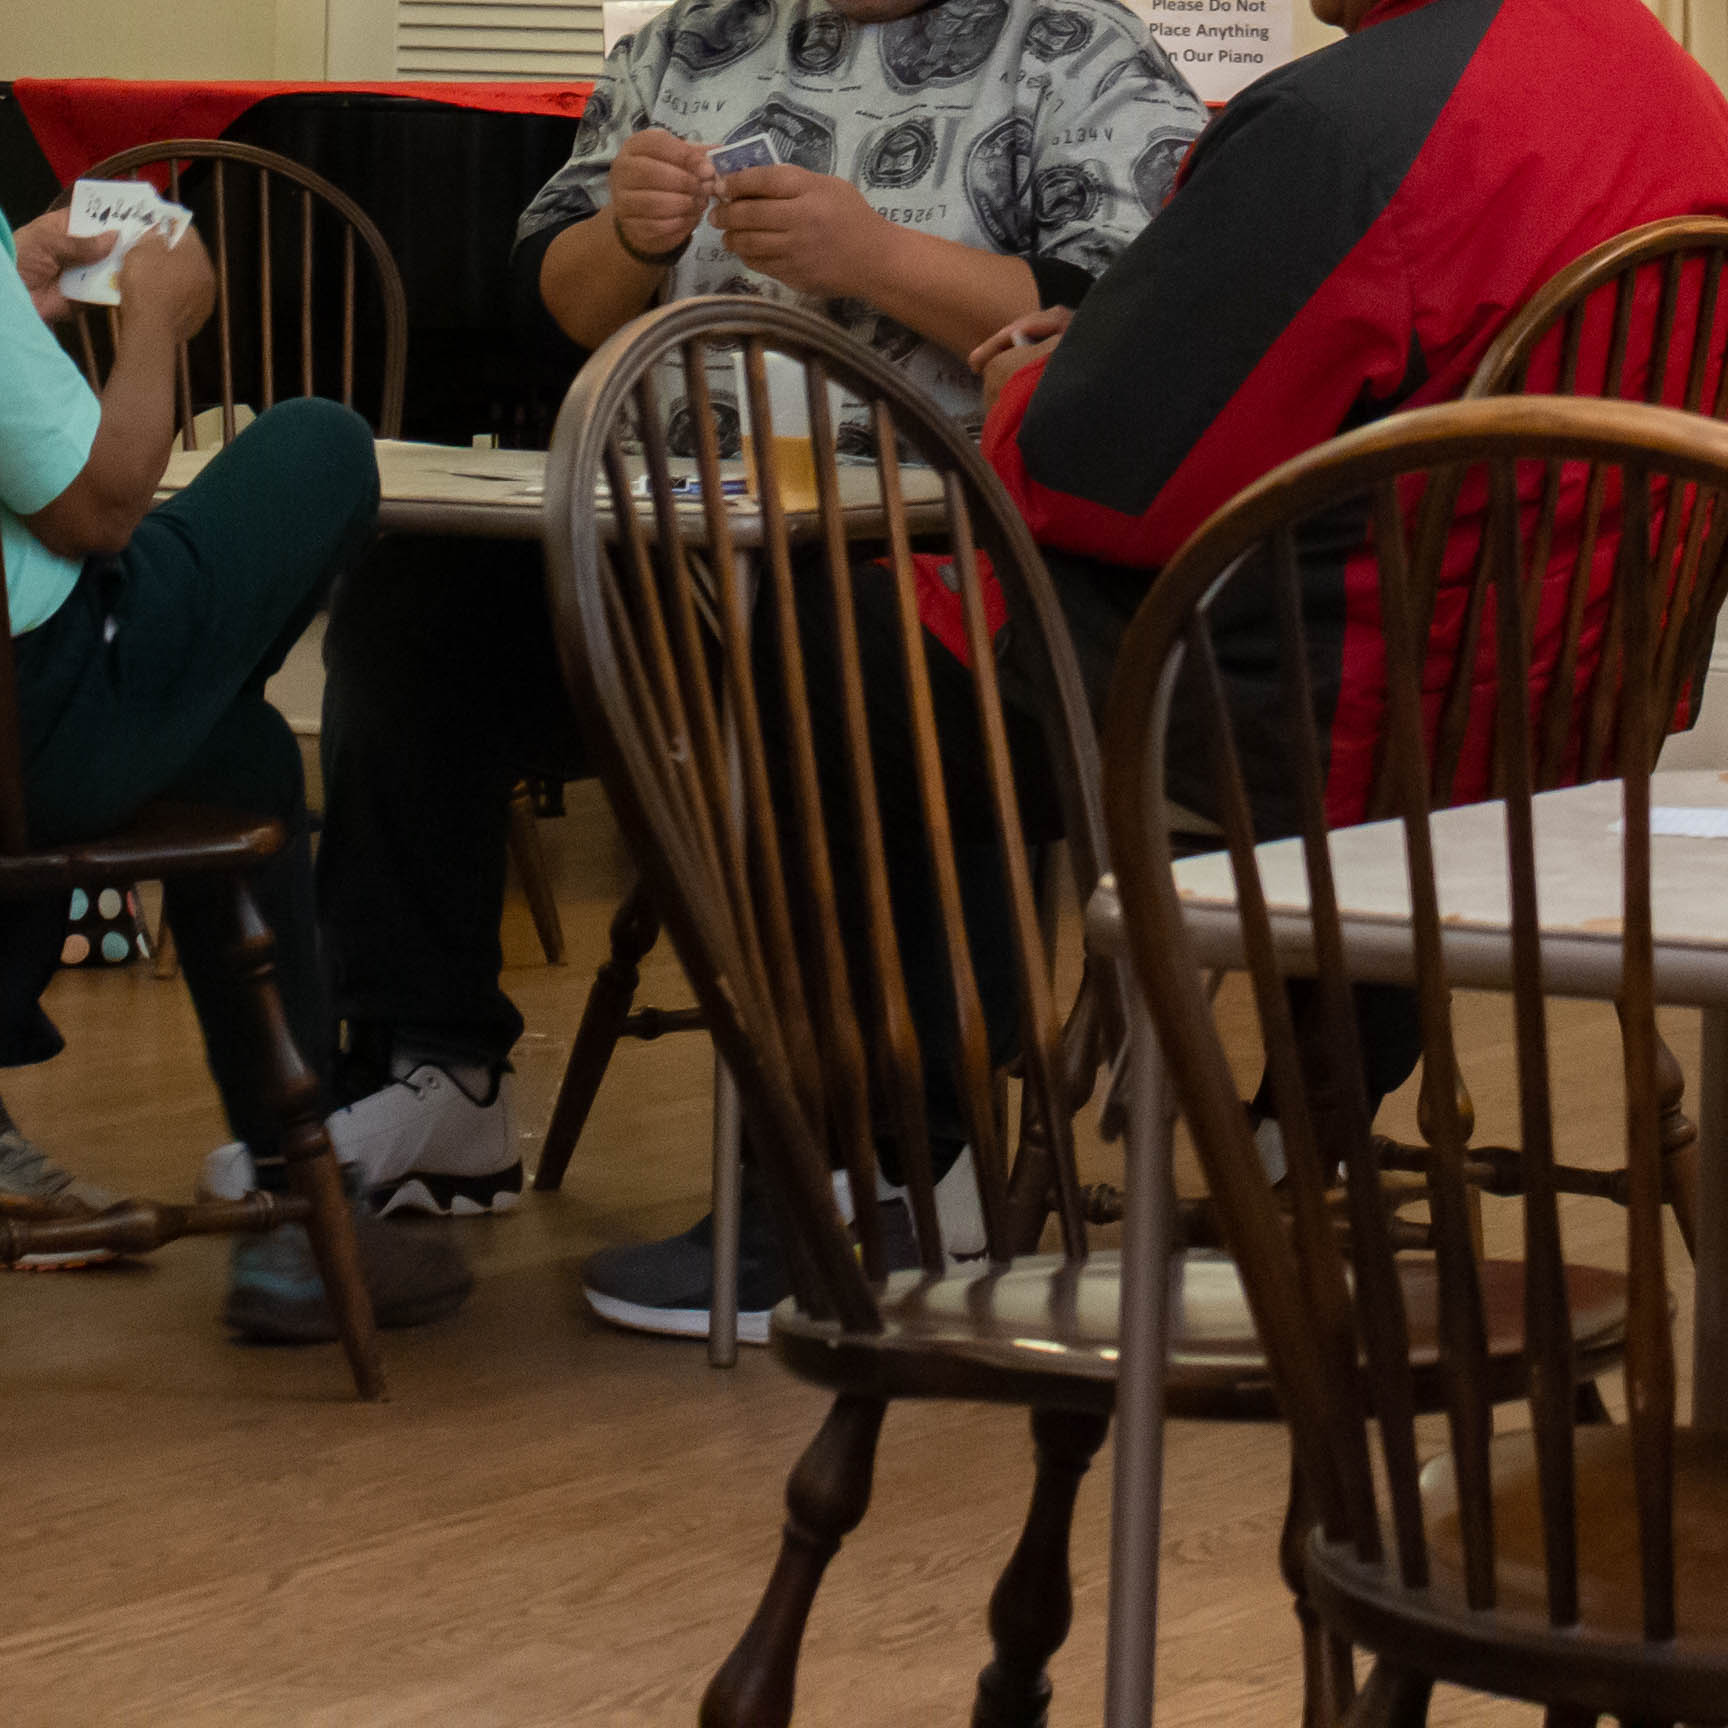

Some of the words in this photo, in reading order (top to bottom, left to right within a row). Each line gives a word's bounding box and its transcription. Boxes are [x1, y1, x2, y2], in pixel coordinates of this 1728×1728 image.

[1236, 0, 1266, 12] Not
[1149, 23, 1191, 36] Place
[1196, 24, 1270, 41] Anything
[1183, 49, 1214, 62] Our
[1219, 50, 1264, 63] Piano
